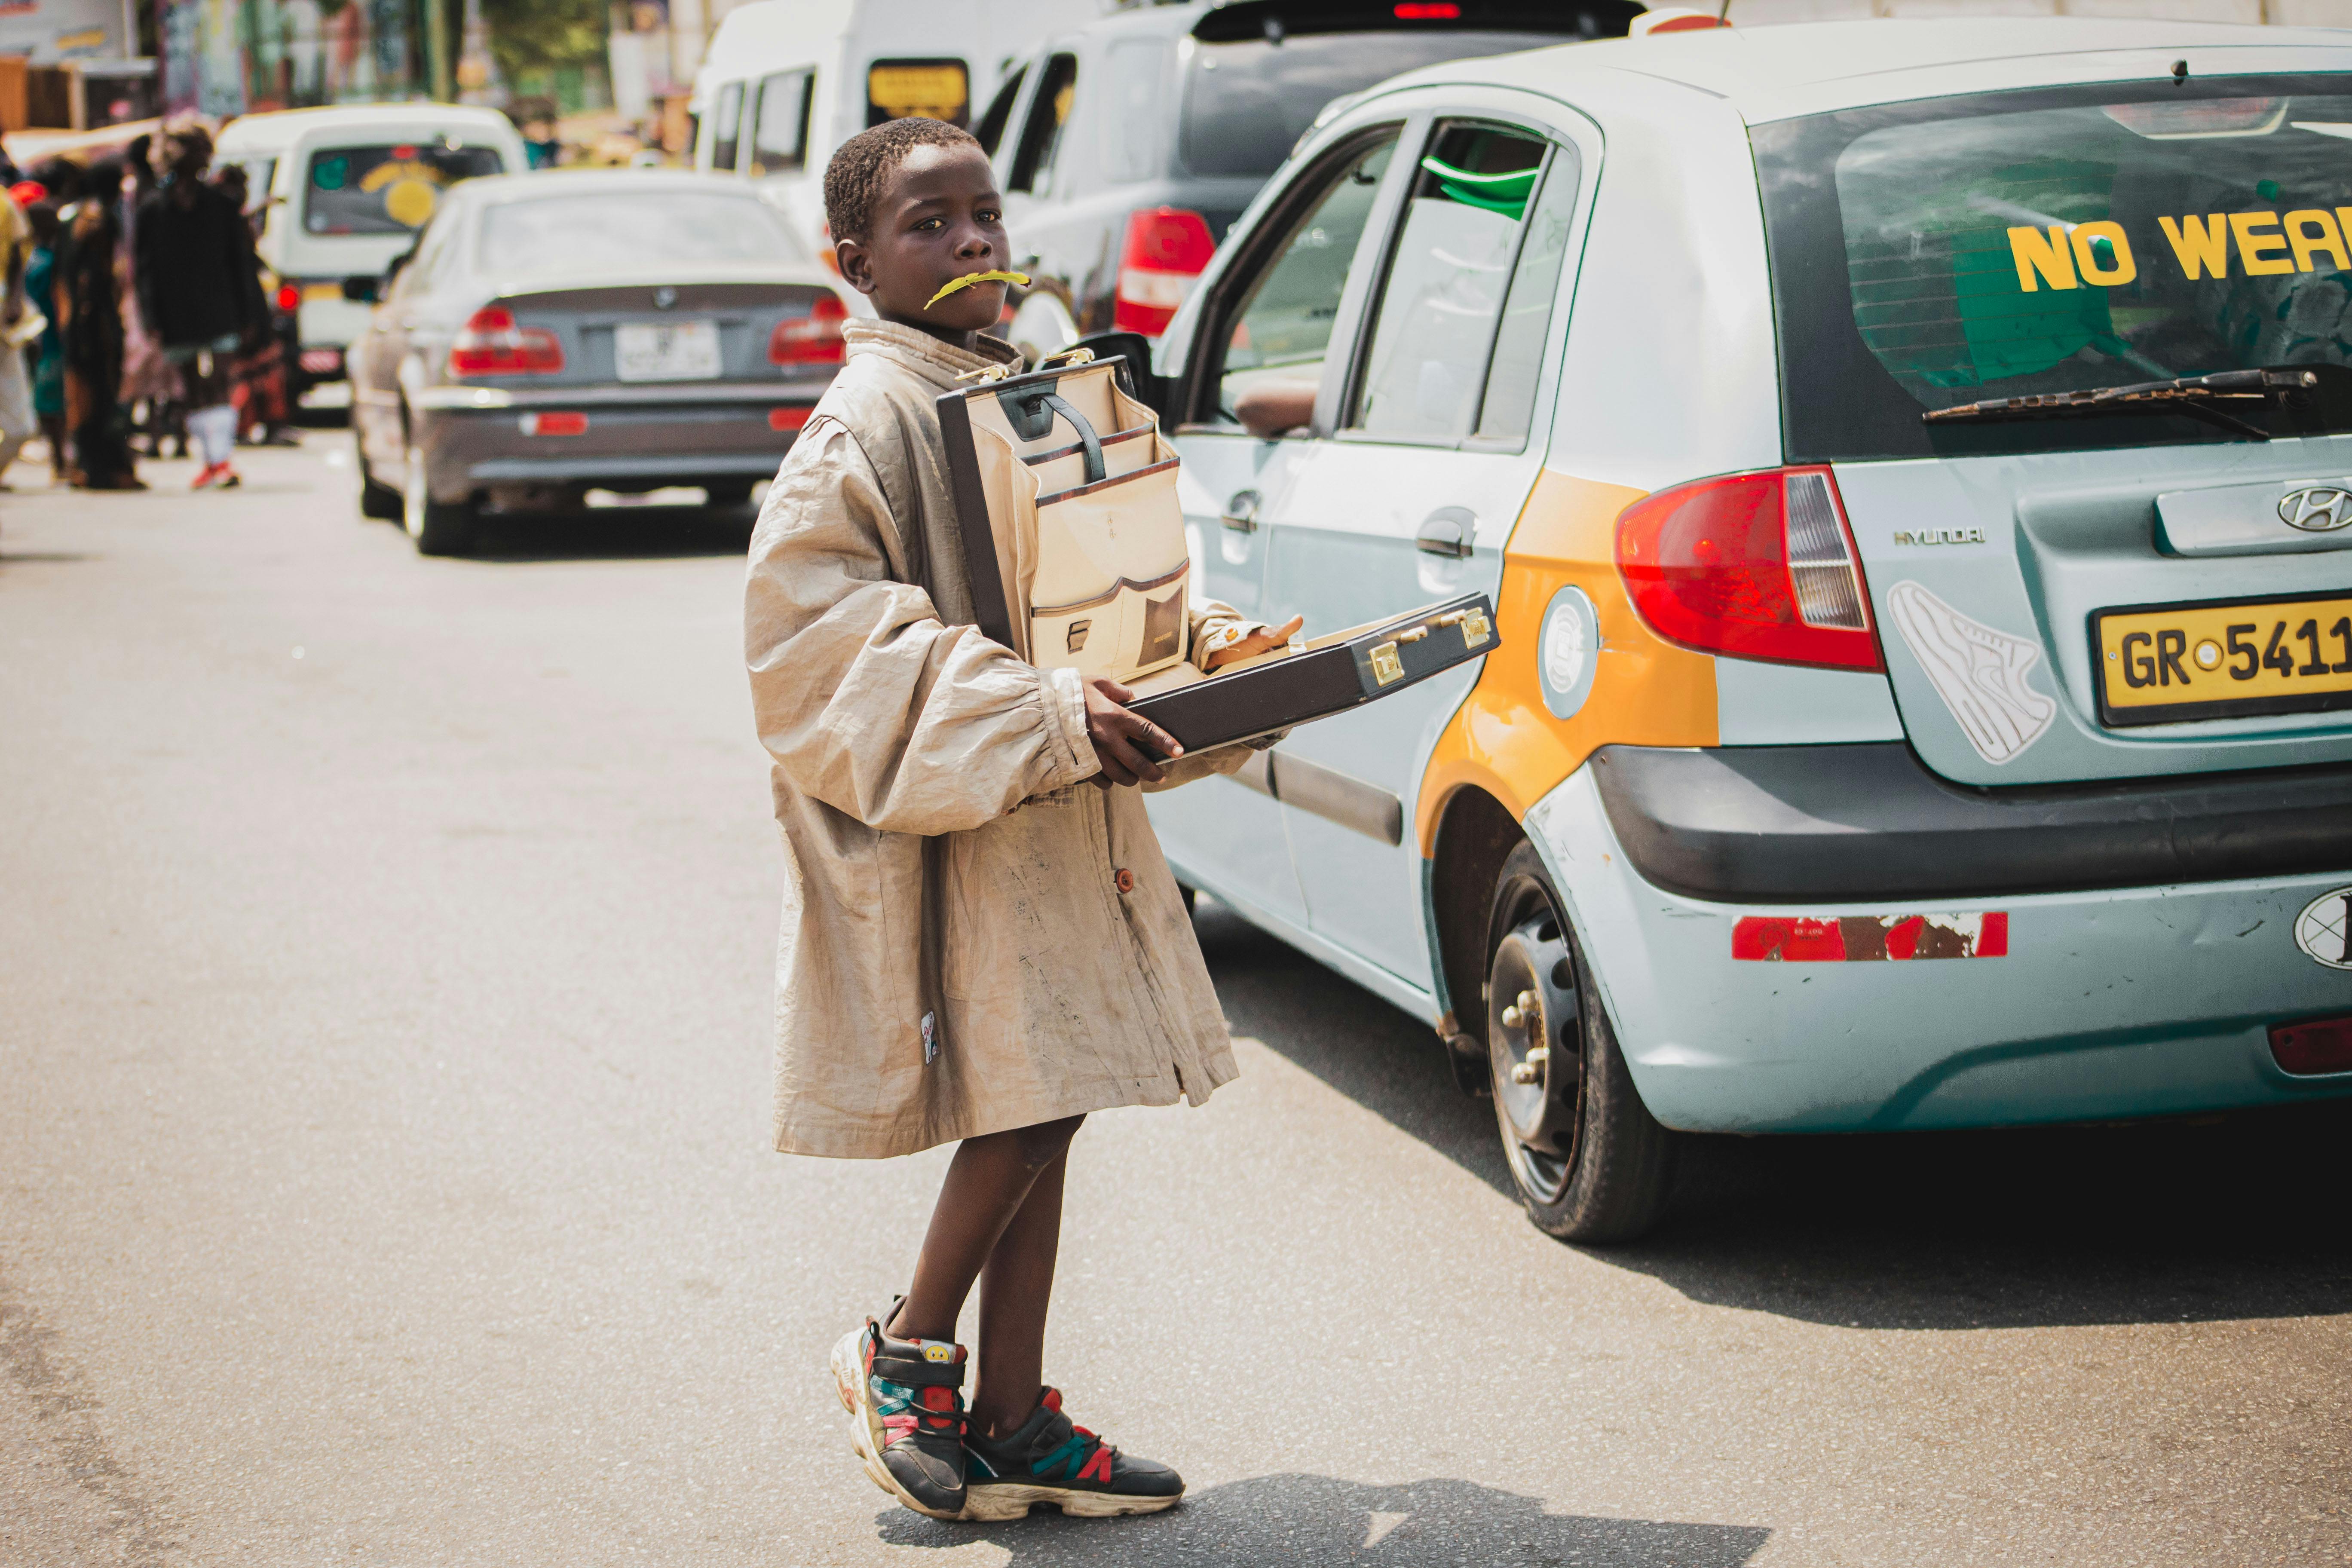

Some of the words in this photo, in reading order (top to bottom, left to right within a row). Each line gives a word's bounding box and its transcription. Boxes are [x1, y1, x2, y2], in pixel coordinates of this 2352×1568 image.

[2007, 220, 2137, 293] NO
[2158, 206, 2352, 280] WEA
[1894, 526, 1986, 545] HYUNDAI
[2122, 629, 2191, 688] GR
[2226, 617, 2352, 680] 5411
